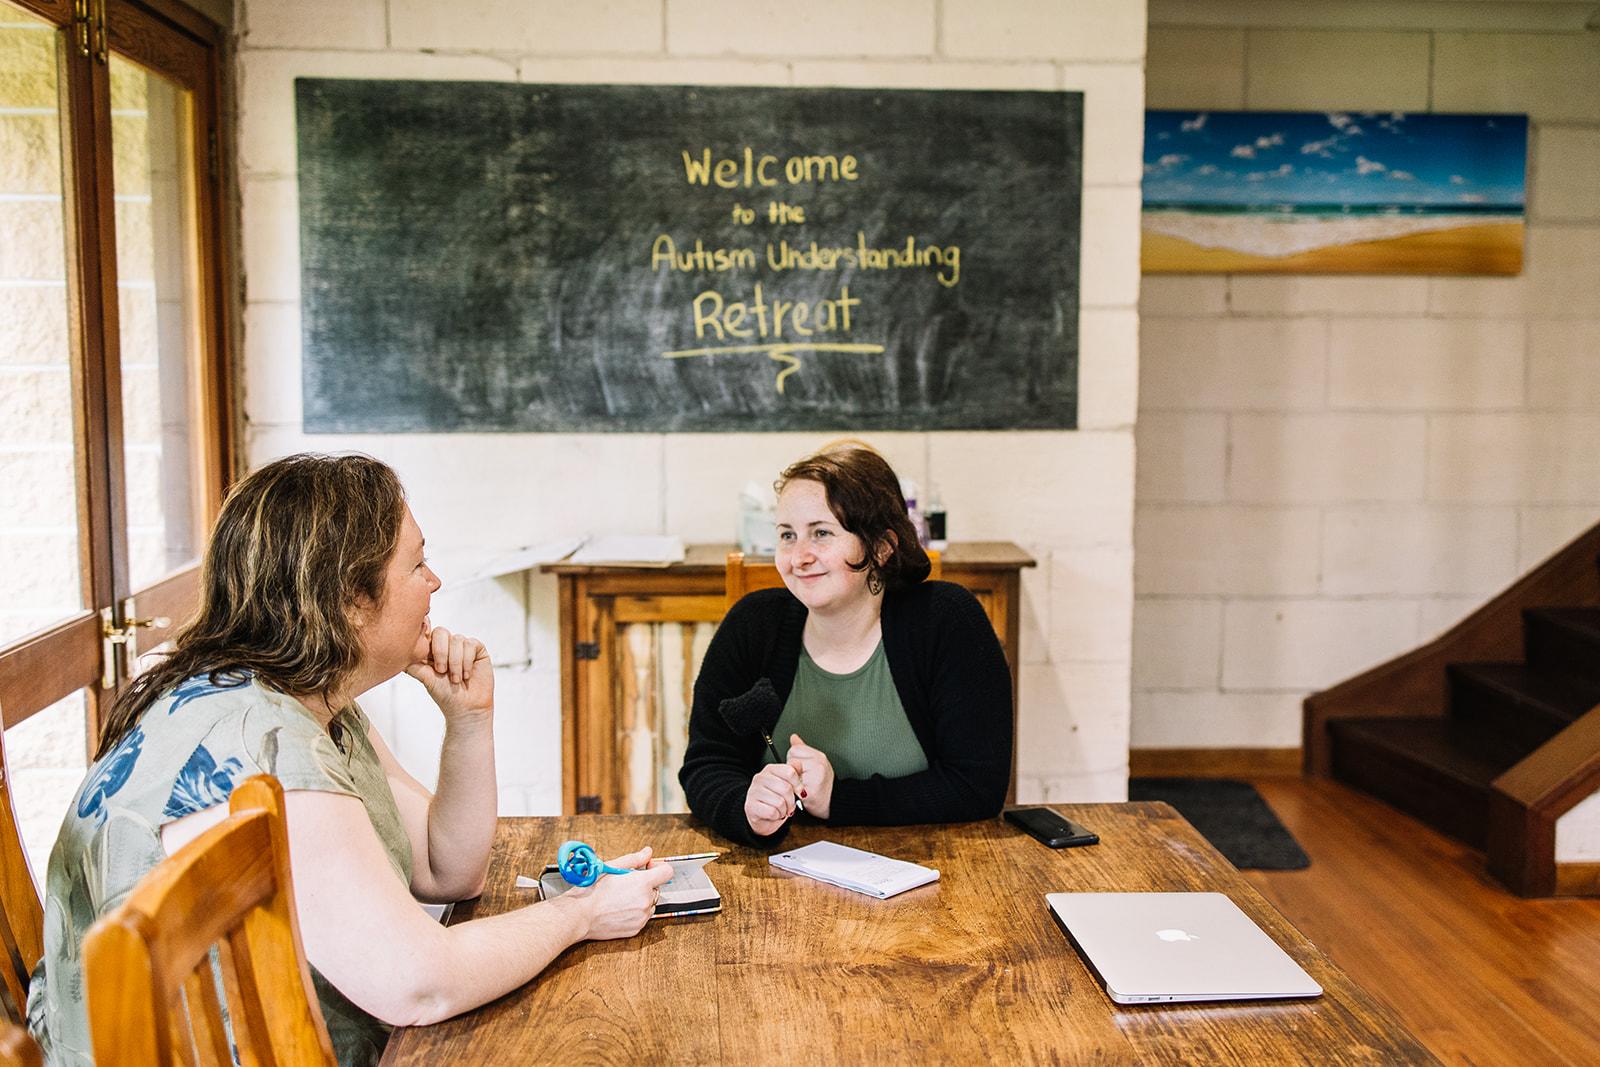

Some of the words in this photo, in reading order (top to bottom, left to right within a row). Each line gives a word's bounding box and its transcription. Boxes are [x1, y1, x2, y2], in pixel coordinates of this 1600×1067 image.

[682, 147, 859, 188] Welcome
[732, 203, 756, 225] to
[768, 201, 806, 225] the
[652, 234, 756, 273] Autism
[767, 230, 961, 288] Understanding
[693, 281, 862, 340] Retreat
